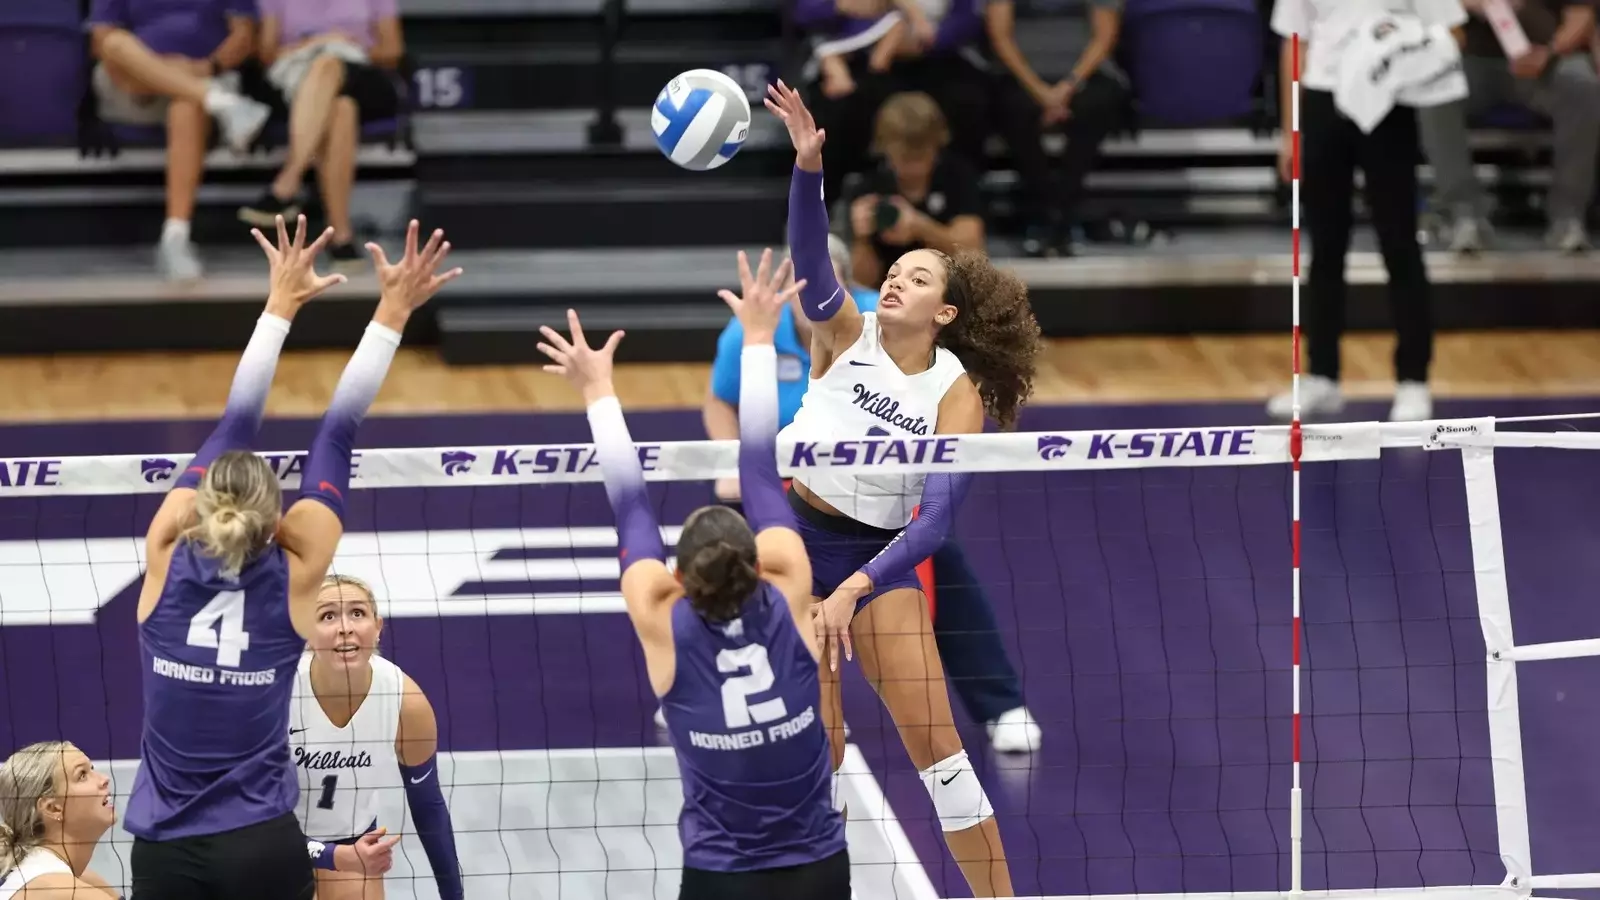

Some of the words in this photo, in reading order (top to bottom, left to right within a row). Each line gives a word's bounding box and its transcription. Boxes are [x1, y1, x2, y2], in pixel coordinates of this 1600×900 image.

[412, 67, 462, 107] 15
[852, 383, 928, 436] Wildcats
[1087, 430, 1255, 459] K-STATE
[1446, 425, 1478, 433] Senoh
[492, 446, 661, 475] K-STE
[790, 438, 958, 467] K-STATE
[186, 589, 249, 667] 4
[153, 656, 214, 684] HORNED
[220, 668, 276, 686] FROGS
[716, 643, 787, 729] 2
[689, 730, 764, 750] HORNED
[768, 705, 815, 742] FROGS
[294, 747, 372, 769] Wildcats
[316, 775, 338, 810] 1
